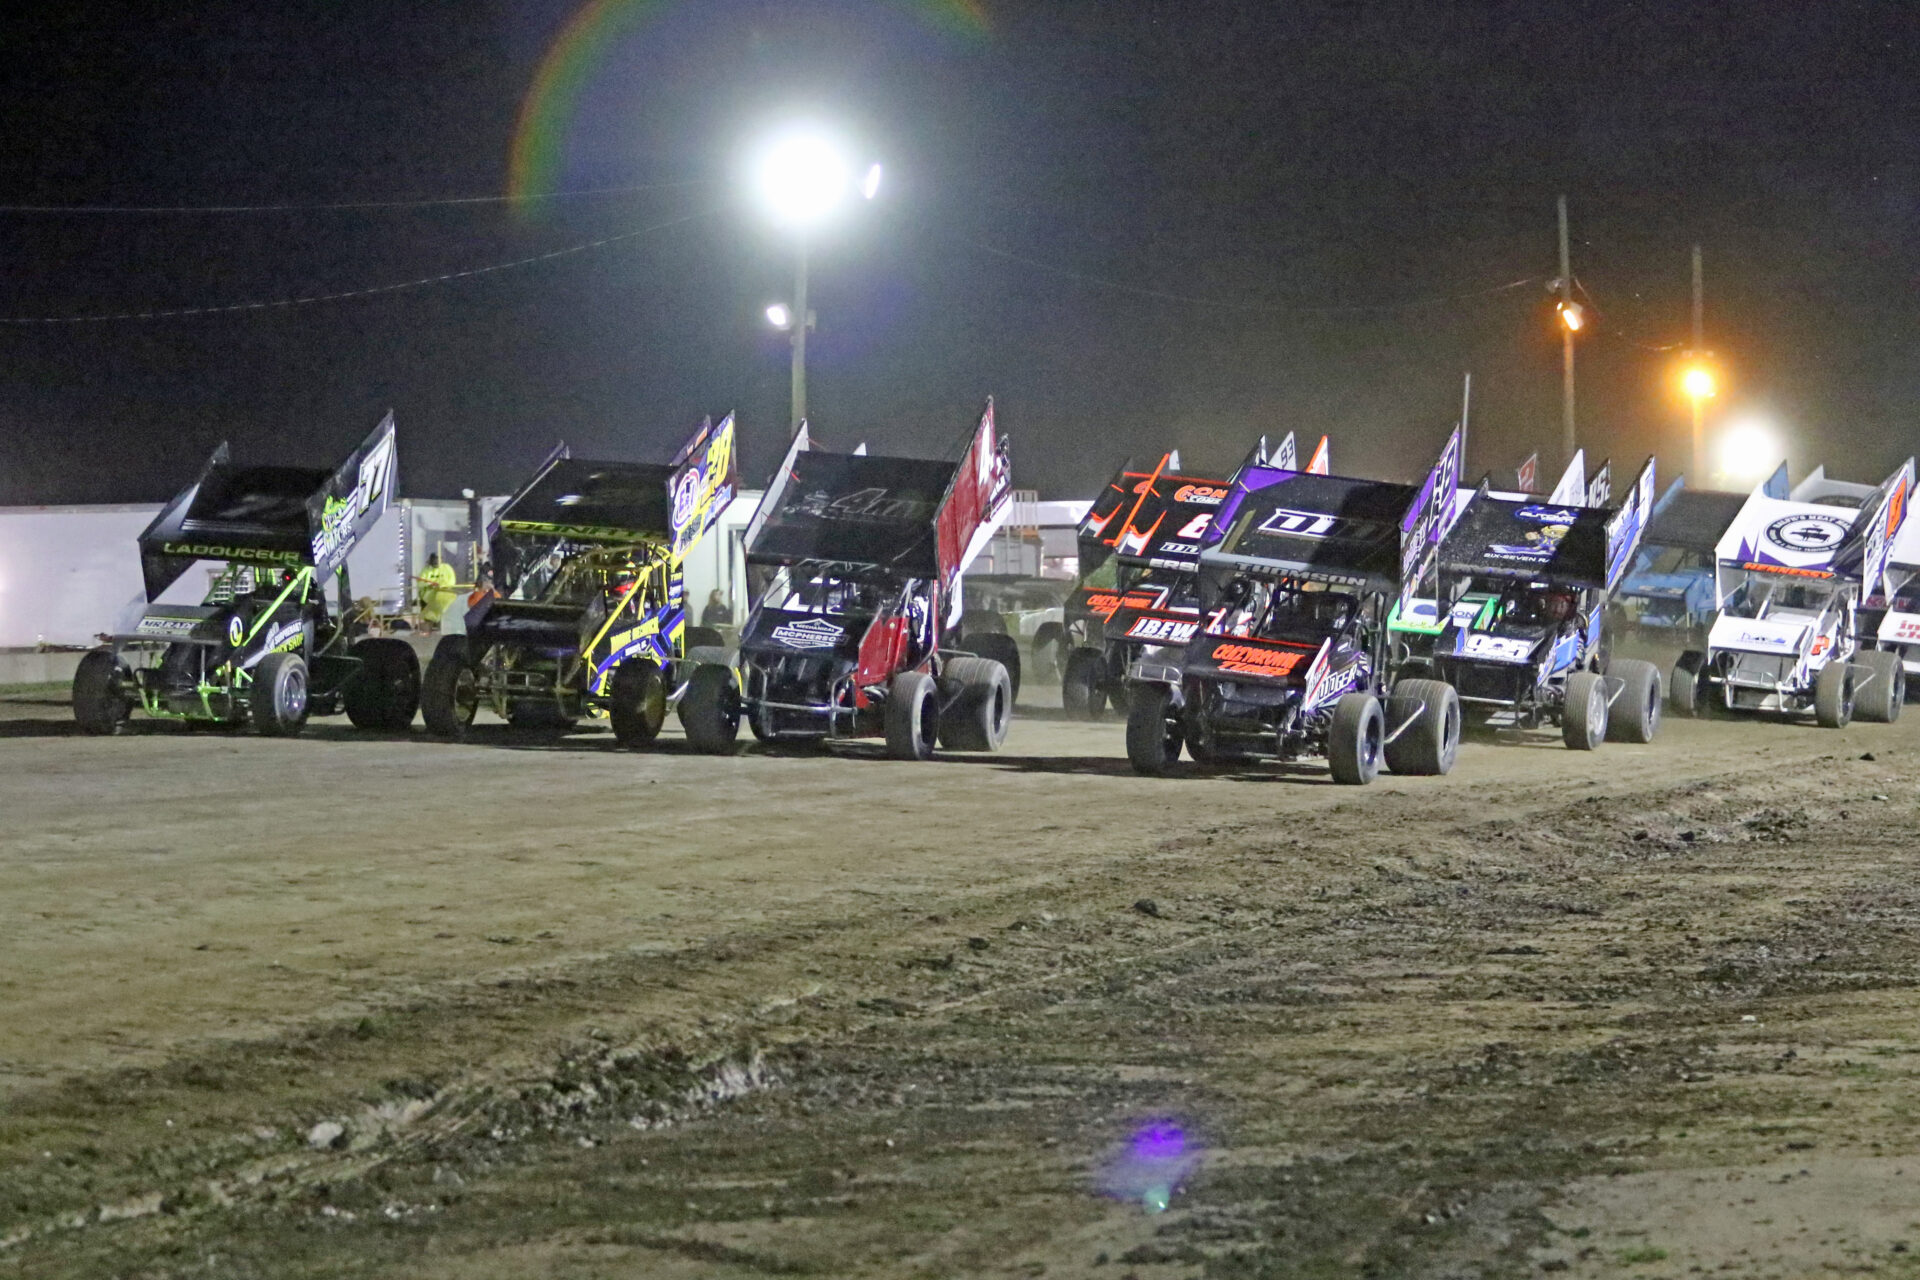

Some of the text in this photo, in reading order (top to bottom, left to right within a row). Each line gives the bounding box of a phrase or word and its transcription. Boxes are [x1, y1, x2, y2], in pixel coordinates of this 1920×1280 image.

[163, 542, 301, 562] LADOUCEUR
[1234, 561, 1367, 587] THOMSON
[1743, 561, 1834, 580] HENNESSY
[796, 623, 836, 633] MECHANICAL
[1134, 618, 1200, 637] IBEW
